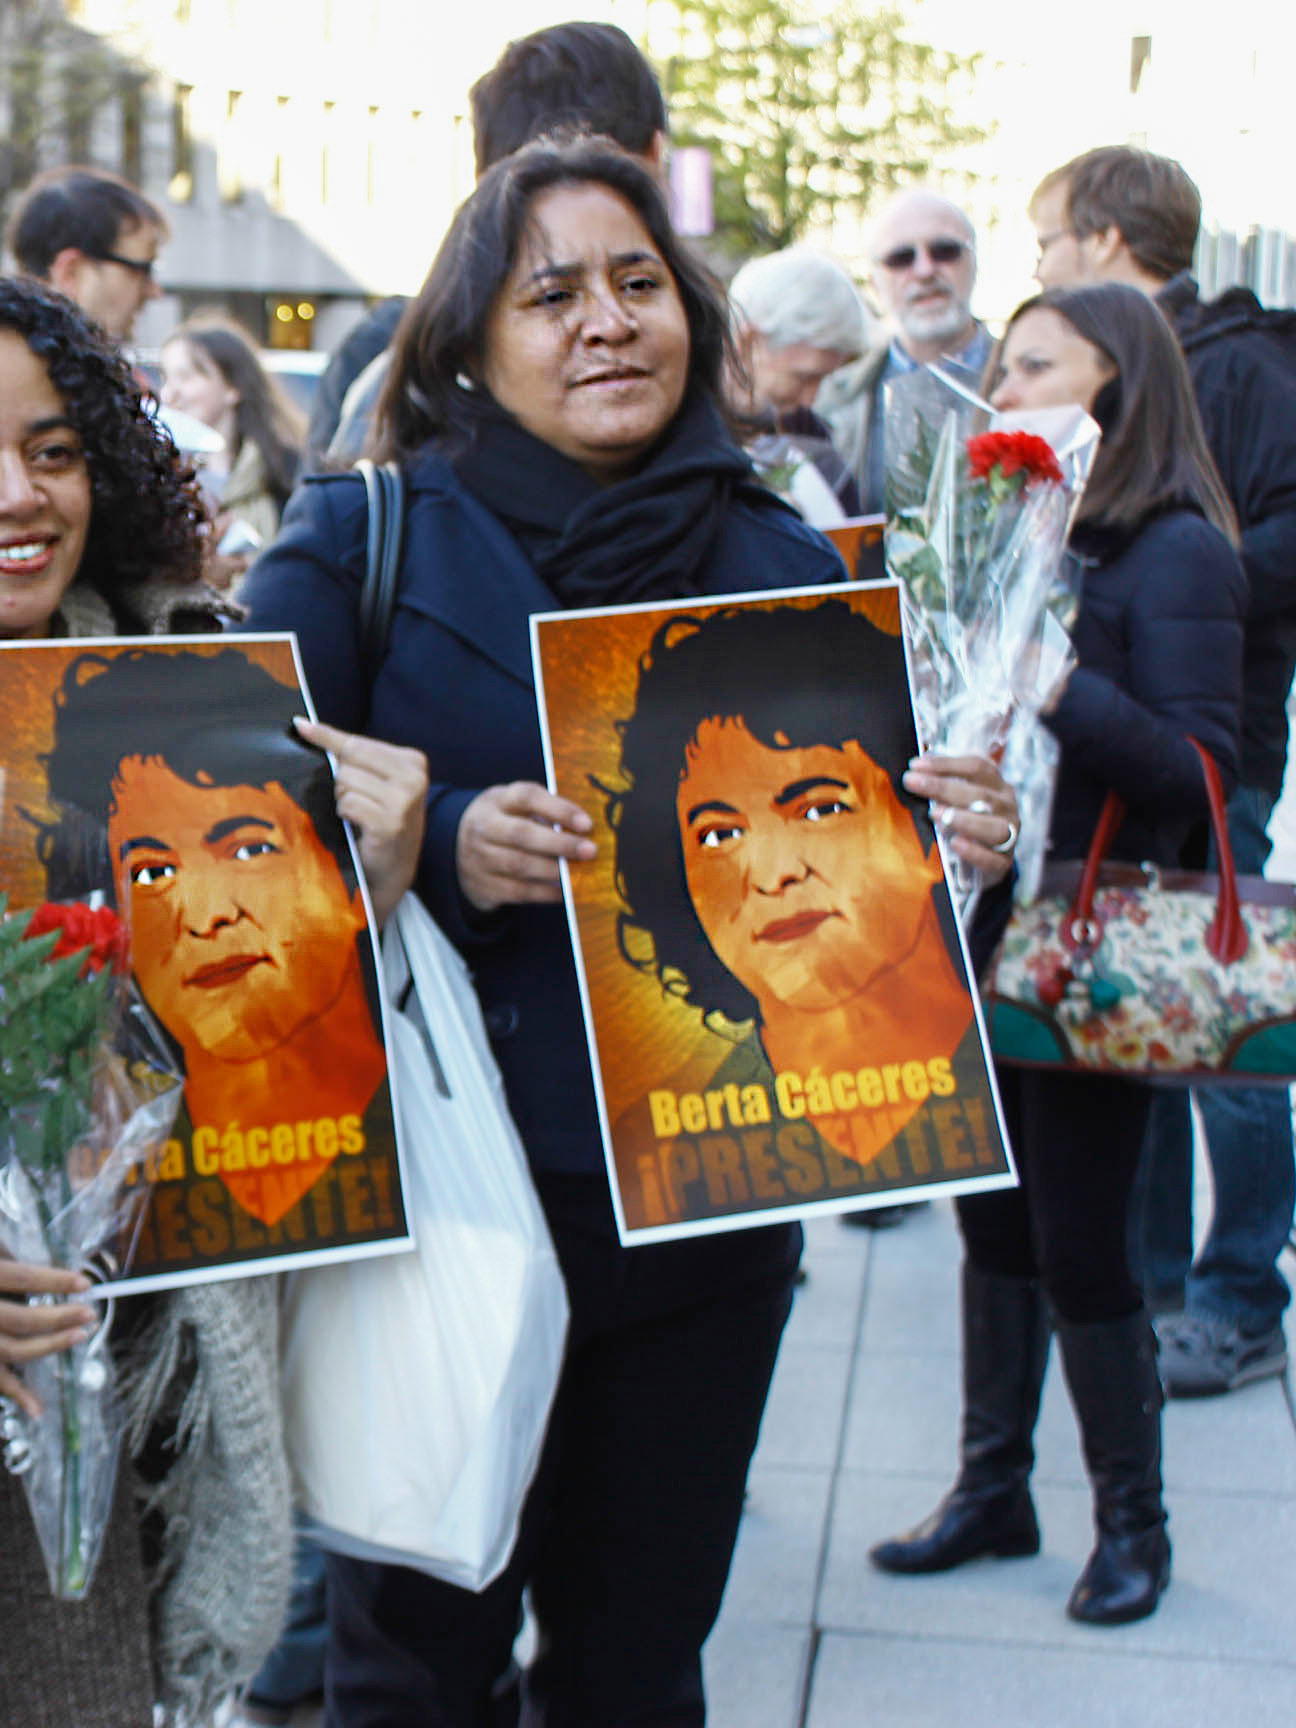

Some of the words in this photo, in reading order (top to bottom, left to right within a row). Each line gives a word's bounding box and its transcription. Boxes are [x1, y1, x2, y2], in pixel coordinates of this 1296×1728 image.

[649, 1082, 771, 1138] Berta
[775, 1055, 957, 1119] Cáceres
[191, 1113, 366, 1177] Cáceres
